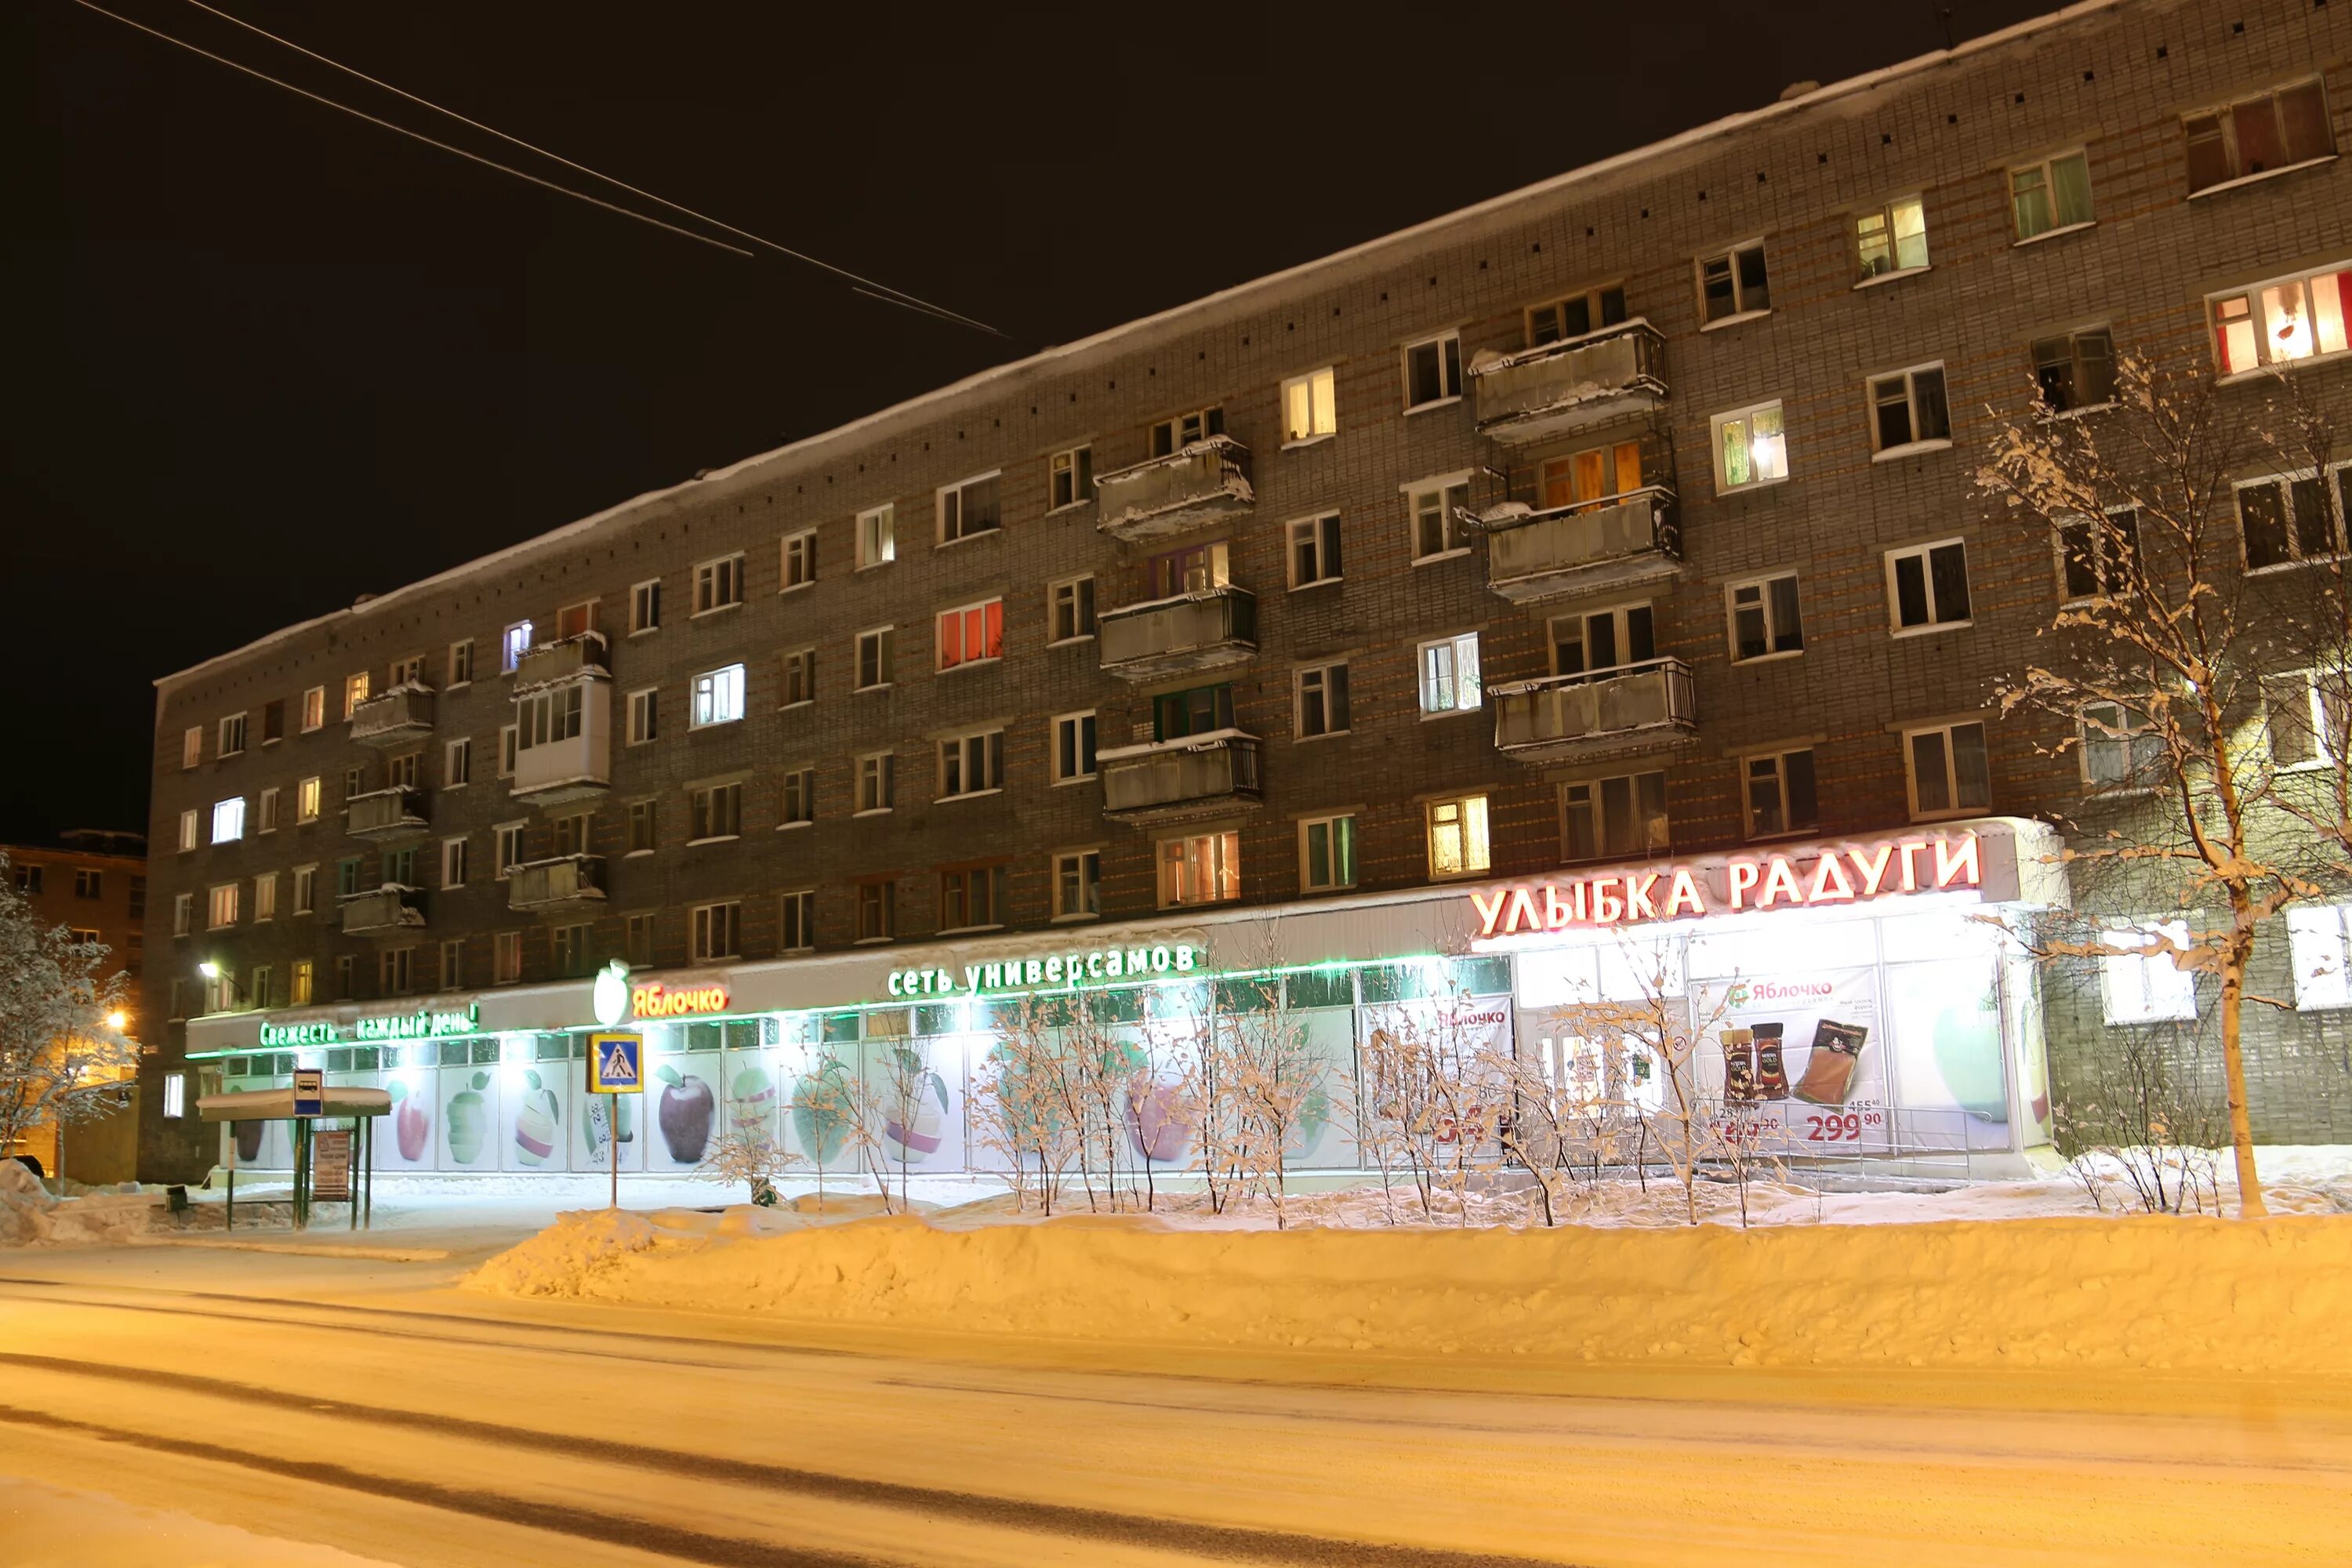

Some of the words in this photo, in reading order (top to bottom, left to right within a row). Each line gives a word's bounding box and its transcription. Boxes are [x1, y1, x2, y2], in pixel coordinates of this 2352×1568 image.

[1469, 869, 1708, 936] УЛЫБКА
[1729, 835, 1982, 912] РАДУГИ
[887, 968, 953, 996] сеть
[964, 945, 1195, 997] универсамов
[633, 984, 728, 1017] Яблочко
[1752, 982, 1833, 1000] Яблочко
[260, 1022, 338, 1047] Свежесть
[356, 1010, 429, 1040] каждый
[430, 1003, 477, 1037] день!
[1807, 1113, 1860, 1142] 299
[1864, 1113, 1882, 1125] 90
